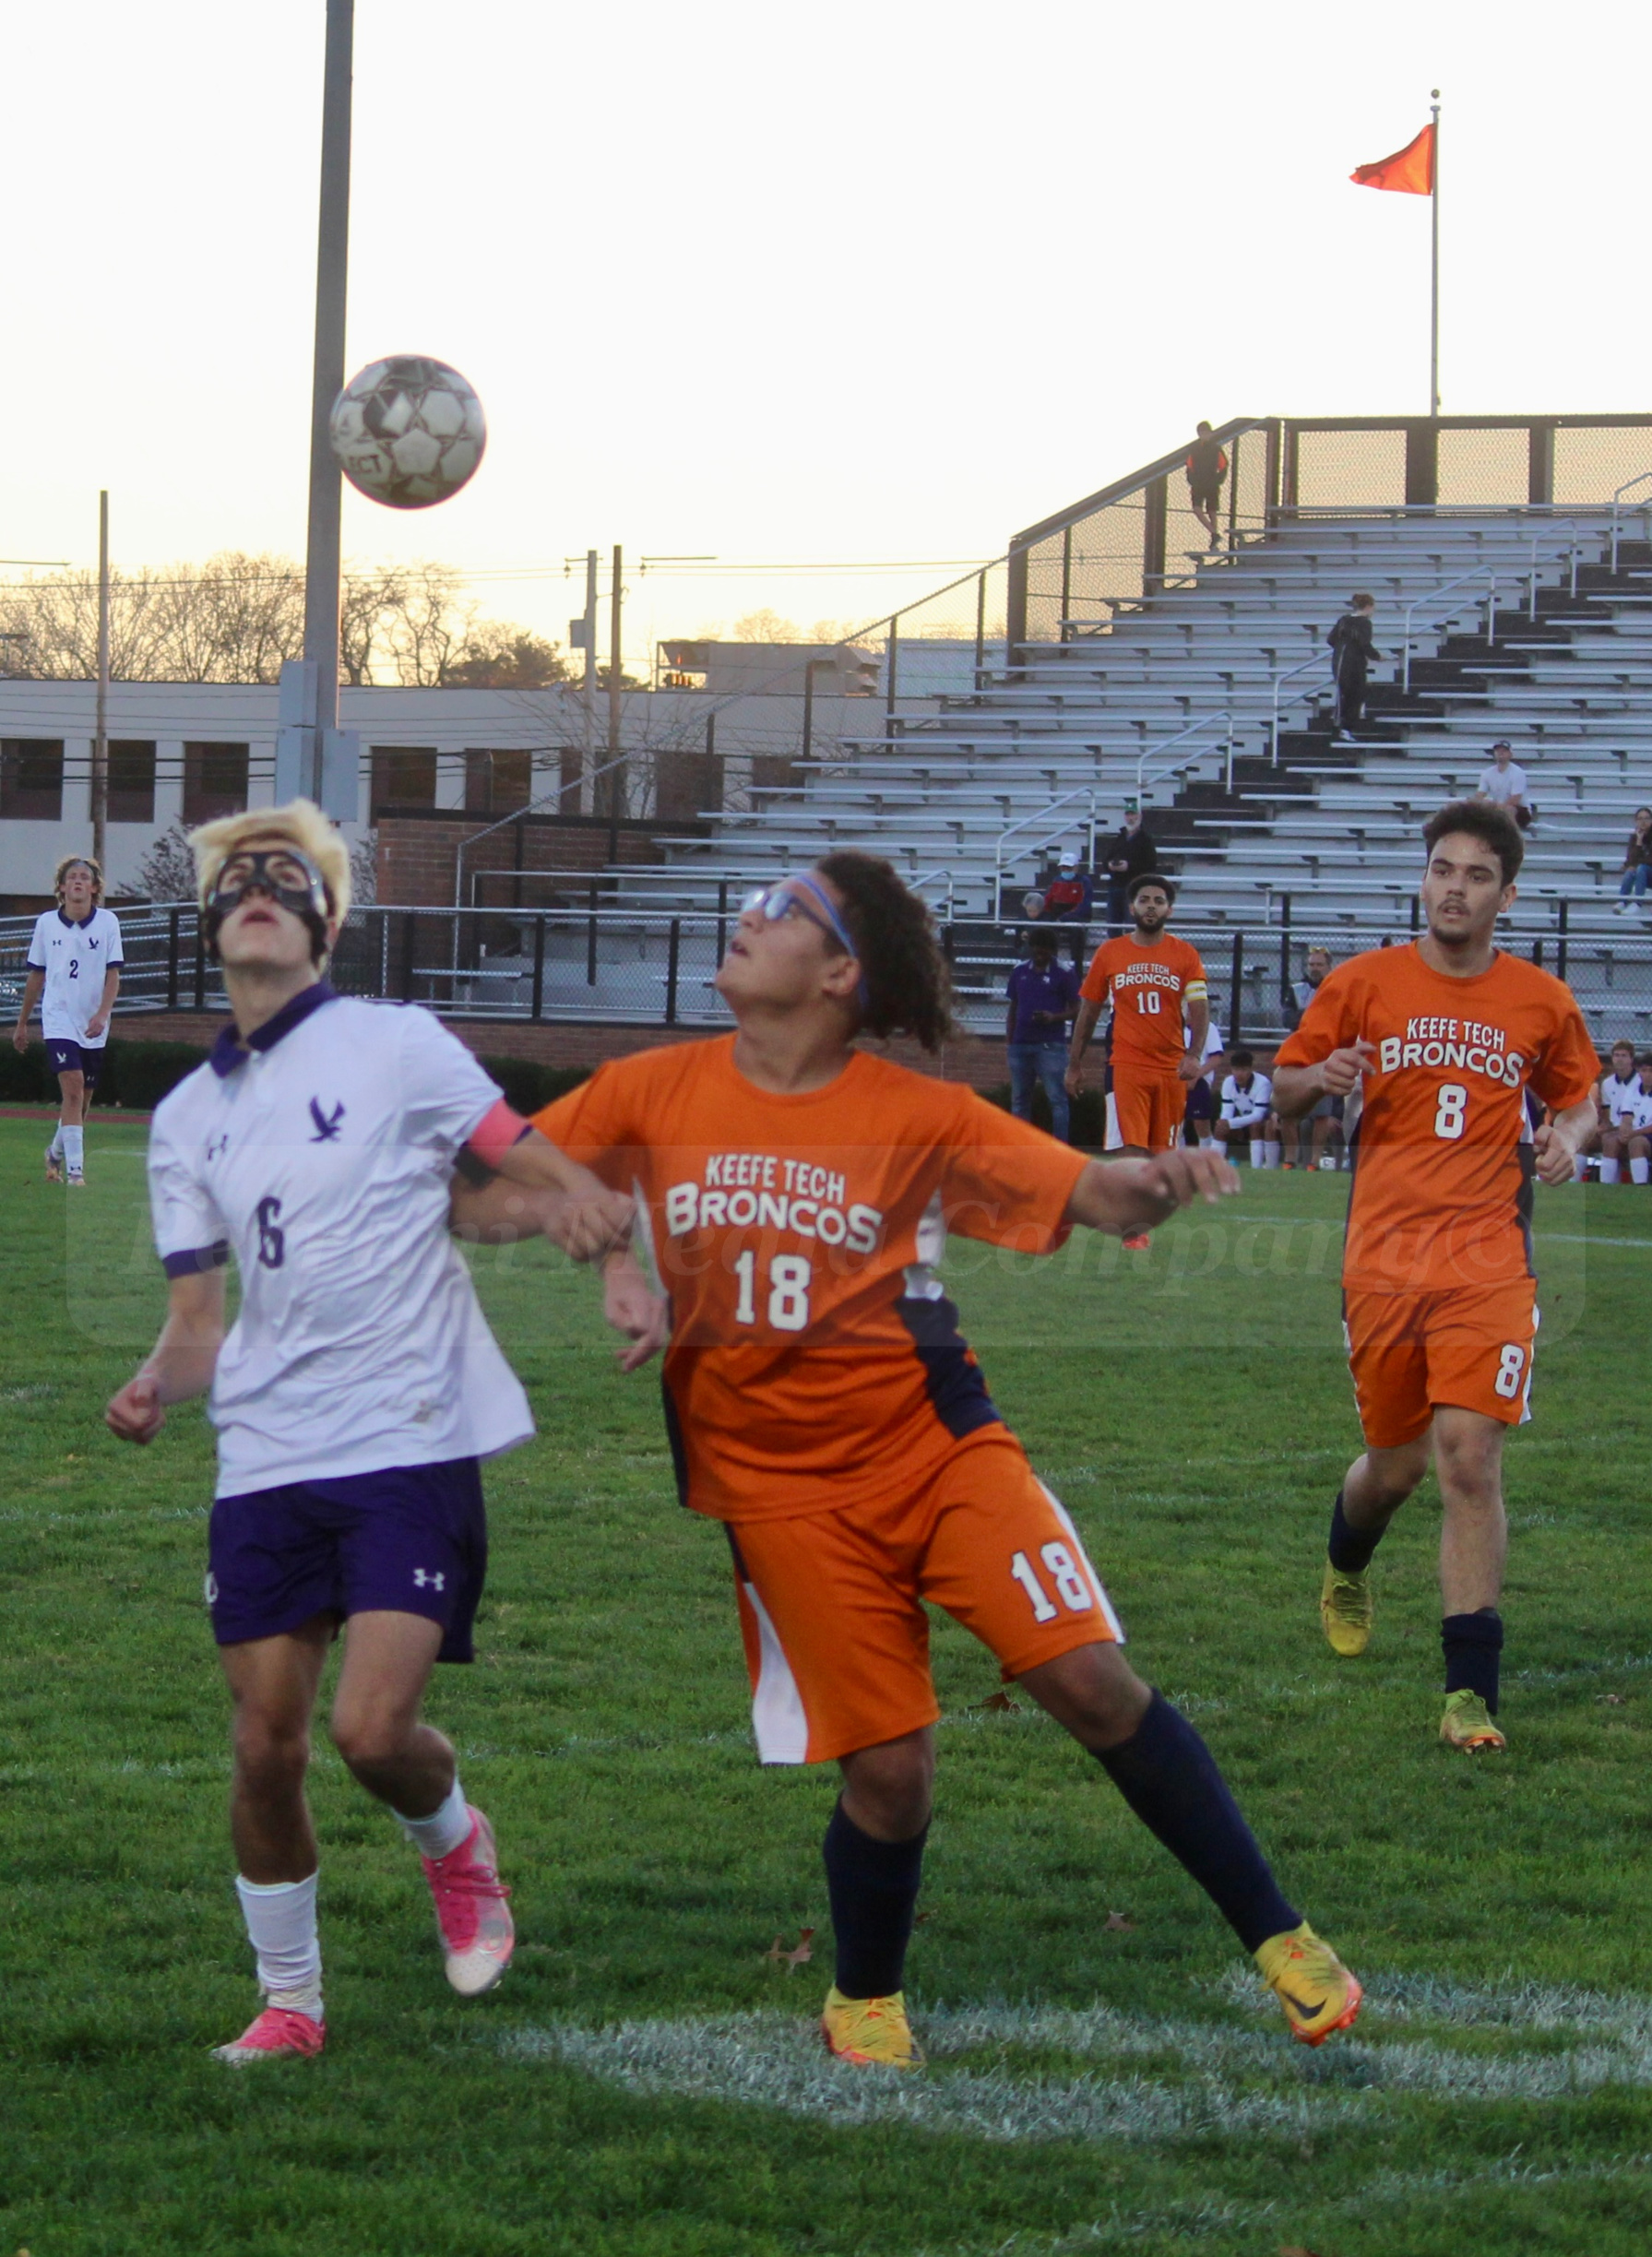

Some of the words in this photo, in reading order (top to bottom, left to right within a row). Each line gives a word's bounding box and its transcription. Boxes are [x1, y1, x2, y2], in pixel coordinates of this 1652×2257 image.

[69, 959, 78, 980] 2
[1114, 973, 1181, 992] BRONCOS
[1127, 963, 1149, 975] KEEFE
[1151, 964, 1170, 975] TECH
[1136, 991, 1160, 1015] 10
[1407, 1016, 1458, 1041] KEEFE
[1462, 1020, 1505, 1052] TECH
[1380, 1037, 1524, 1088] BRONCOS
[1434, 1084, 1468, 1140] 8
[705, 1153, 778, 1189] KEEFE
[783, 1158, 846, 1206] TECH
[257, 1196, 285, 1270] 6
[666, 1182, 883, 1253] BRONCOS
[734, 1250, 812, 1331] 18
[1494, 1344, 1525, 1398] 8
[1011, 1541, 1092, 1623] 18
